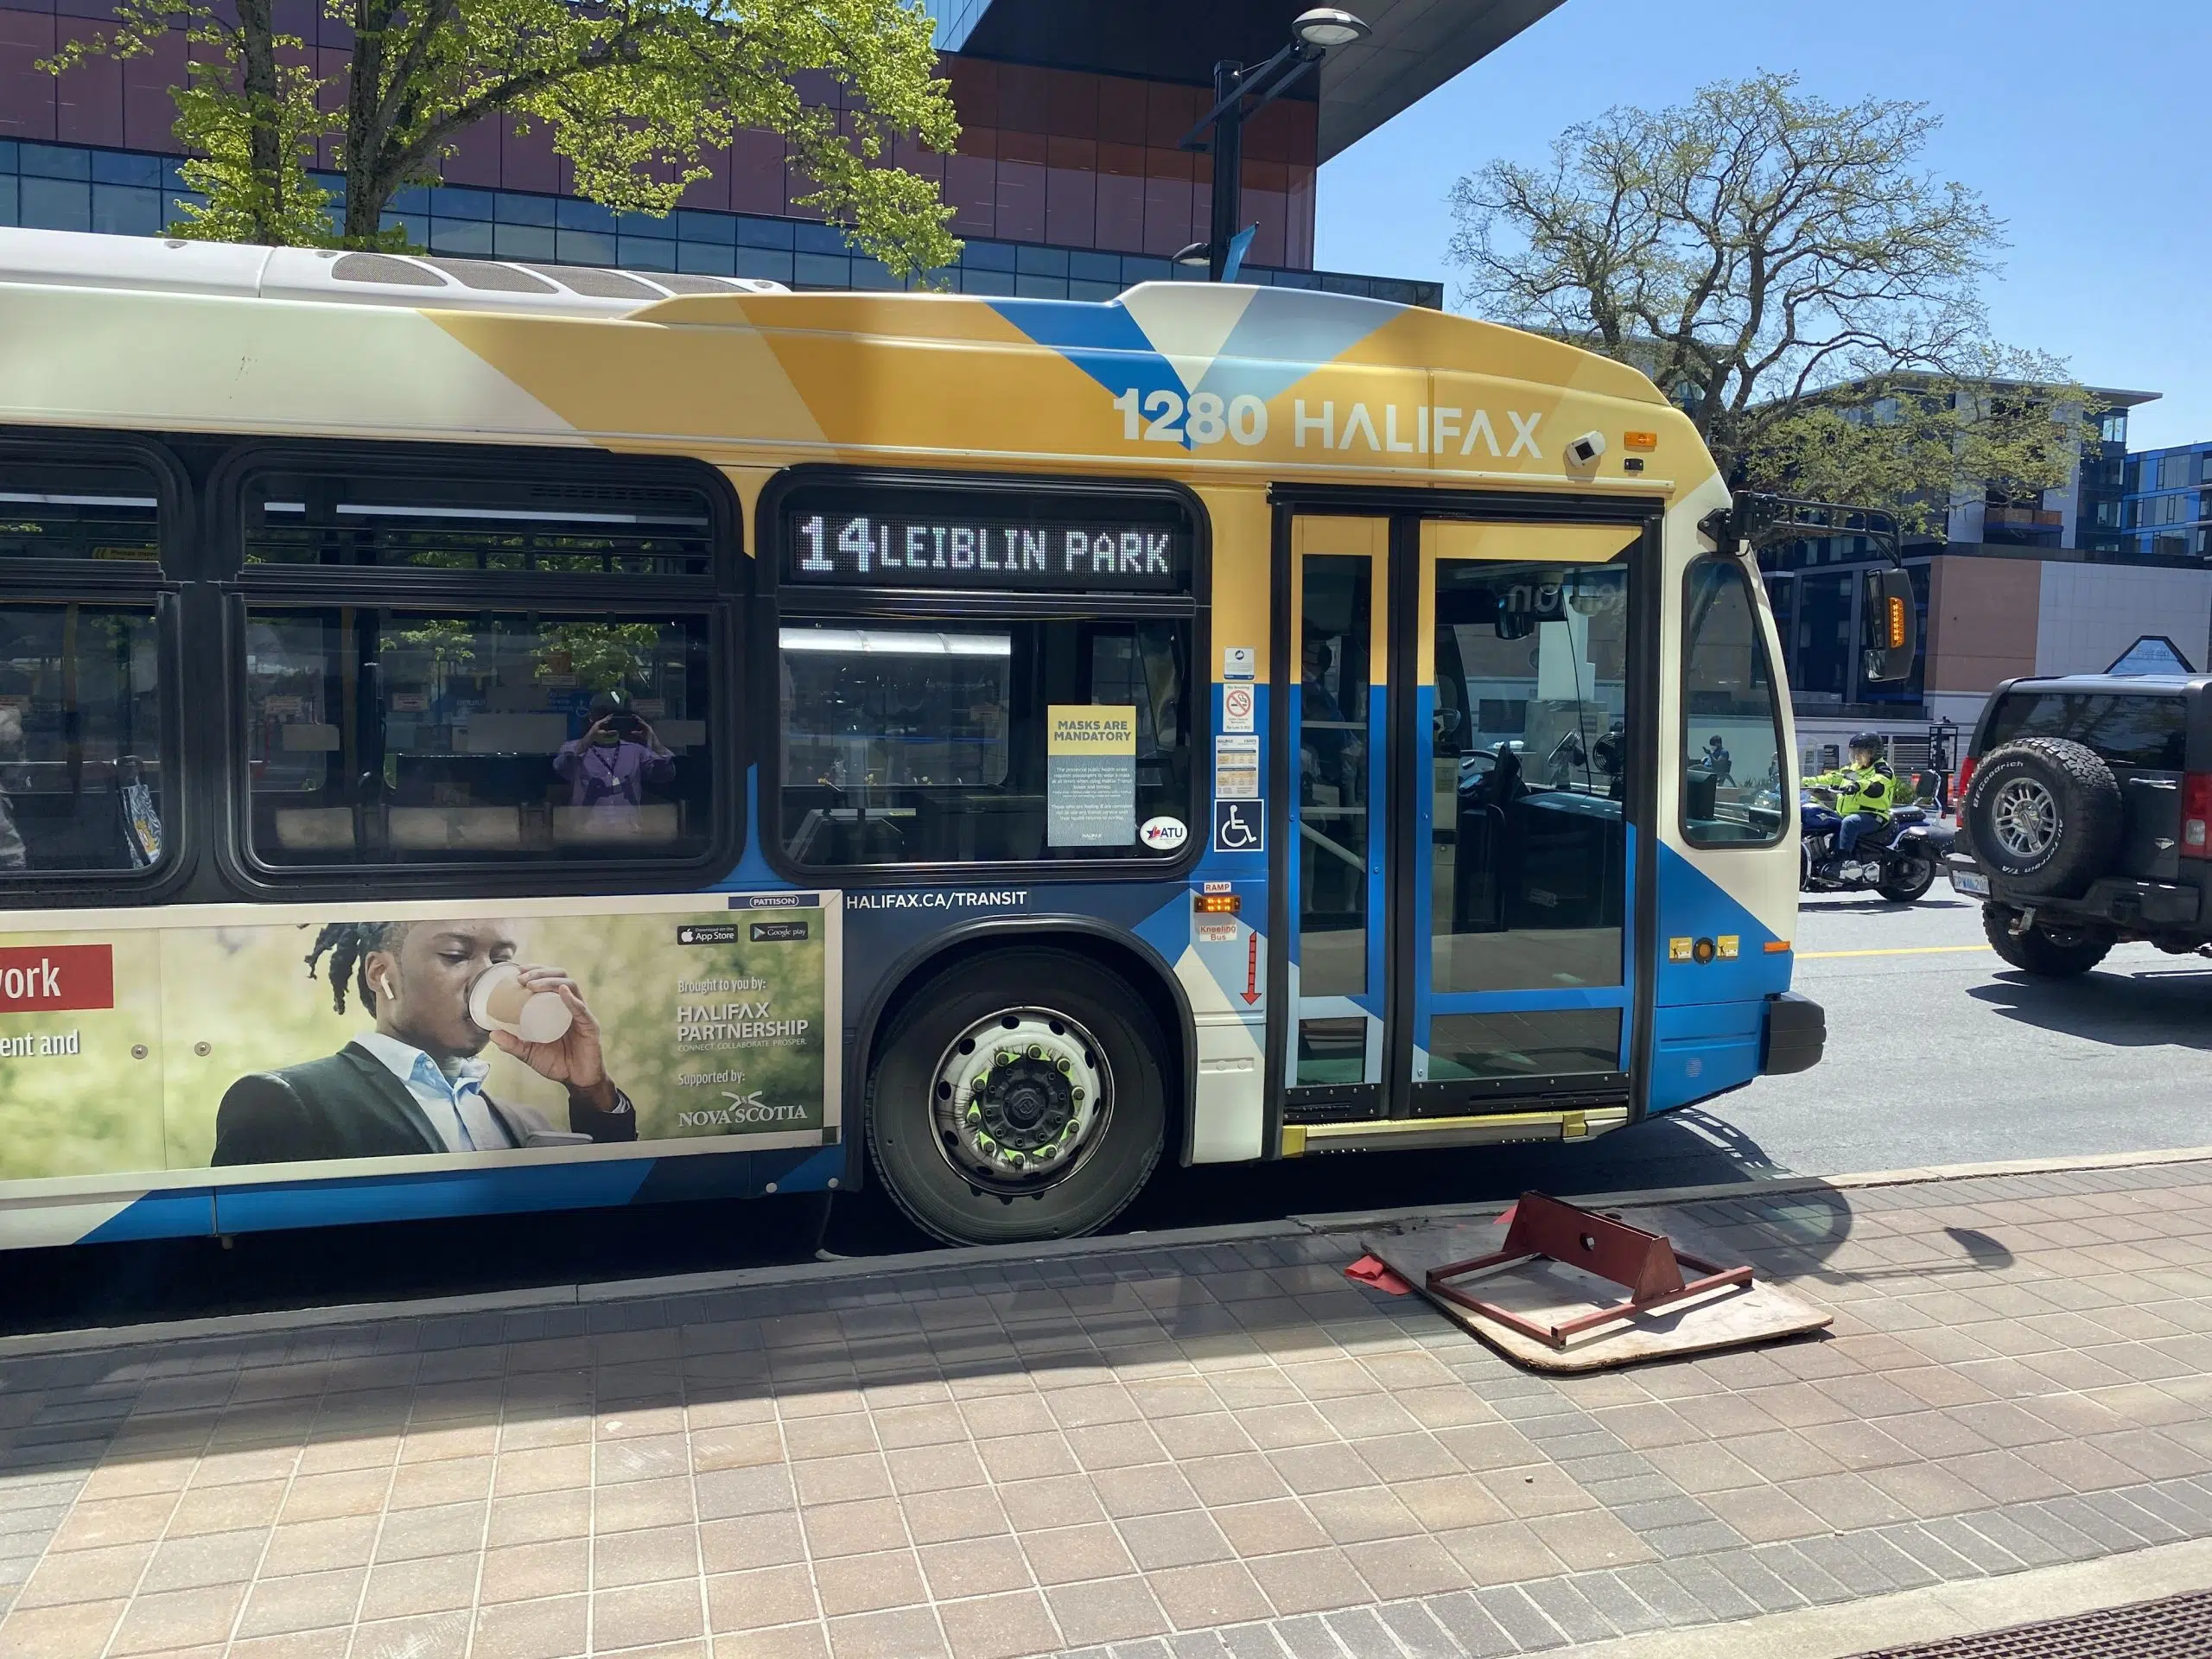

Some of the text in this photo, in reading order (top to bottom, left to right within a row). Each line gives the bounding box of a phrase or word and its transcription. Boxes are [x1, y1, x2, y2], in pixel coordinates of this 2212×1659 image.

[1113, 387, 1268, 446] 1280
[1294, 399, 1544, 459] HALIFAX
[801, 516, 1169, 573] 14 LEIBLIN PARK
[1058, 721, 1128, 730] MASKS ARE
[1054, 731, 1131, 741] MANDATORY
[1973, 760, 2024, 808] BFGoodrich
[1160, 827, 1183, 838] ATU
[1205, 883, 1230, 892] RAMP
[753, 897, 796, 906] PATTISON
[846, 891, 1027, 910] HALIFAX.CA/TRANSIT
[696, 931, 734, 942] App Store
[766, 928, 805, 938] Google play
[1200, 925, 1236, 934] Kneeling
[0, 957, 61, 999] ork
[678, 976, 766, 994] Brought to you by:
[677, 1001, 770, 1023] HALIFAX
[677, 1019, 809, 1042] PARTNERSHIP
[40, 1028, 79, 1055] and
[678, 1069, 746, 1086] Supported by:
[678, 1104, 808, 1127] NOVA SCOTIA
